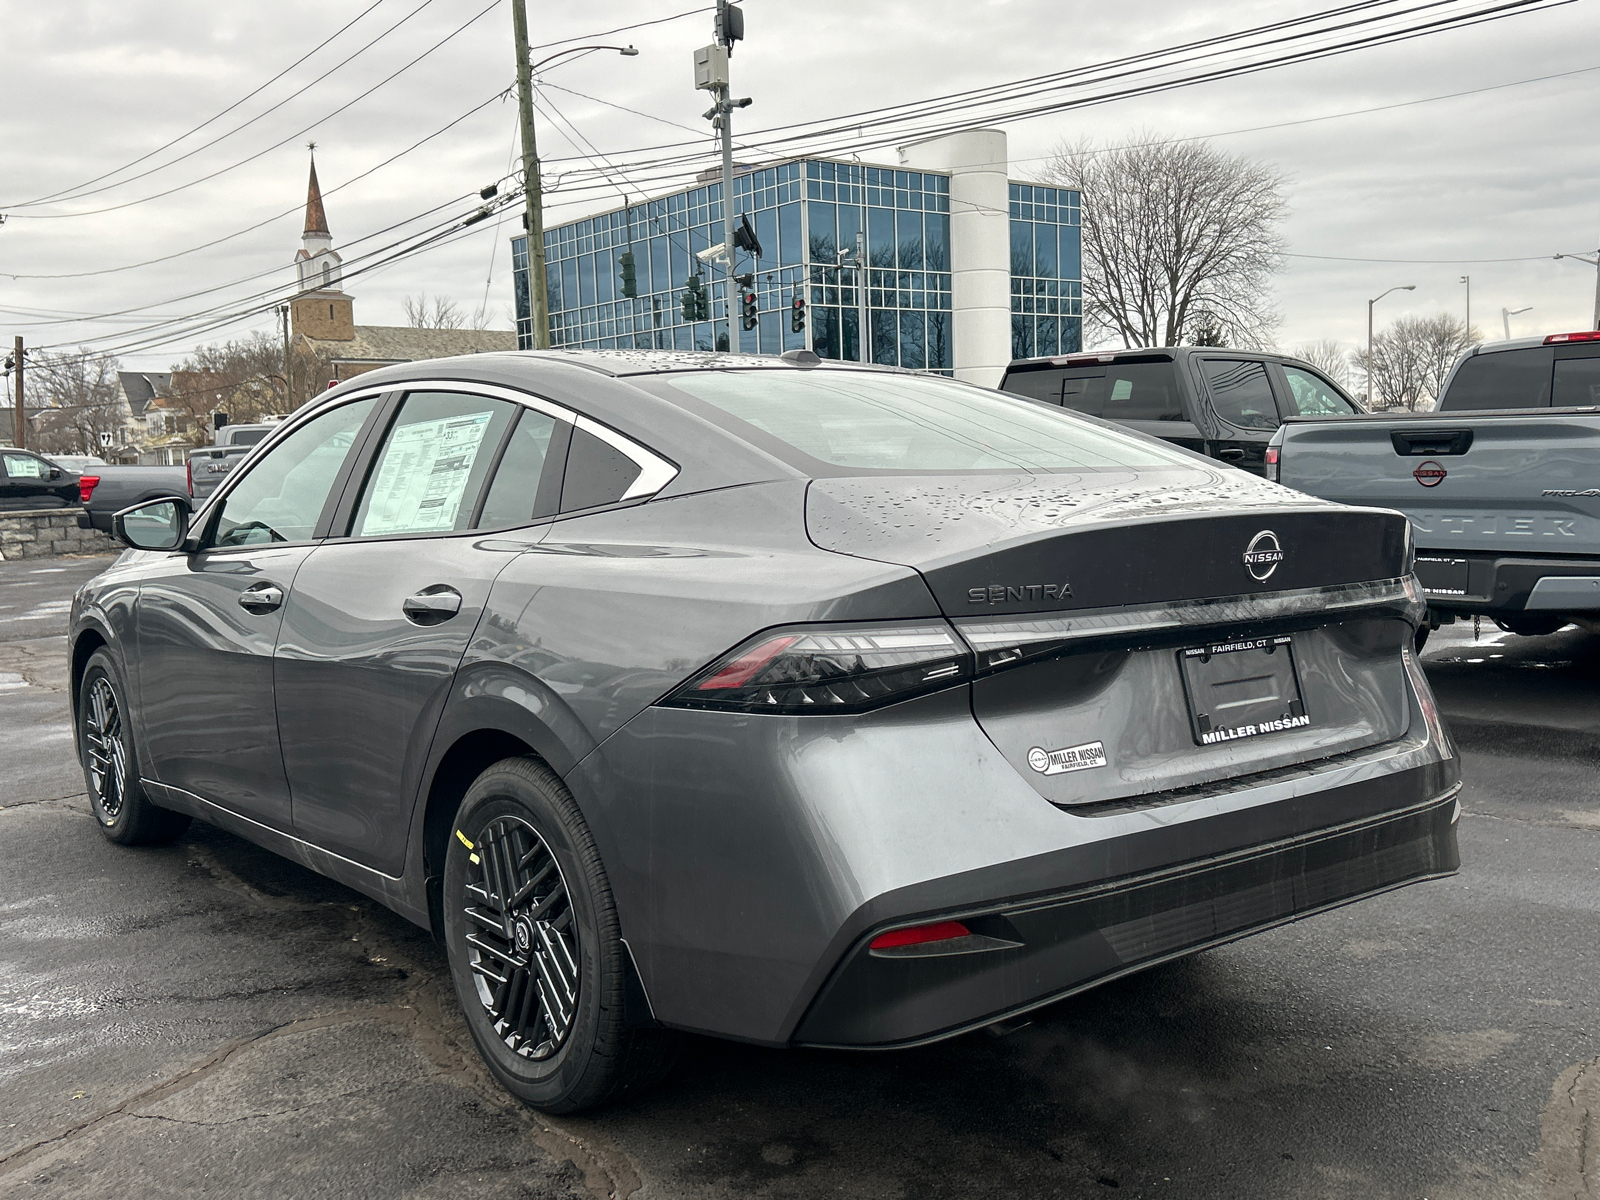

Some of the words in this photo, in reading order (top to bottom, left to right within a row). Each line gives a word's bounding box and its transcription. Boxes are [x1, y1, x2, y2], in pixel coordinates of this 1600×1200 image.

[1406, 514, 1576, 536] NTIER
[1244, 552, 1283, 563] NISSAN
[968, 583, 1073, 603] SENTRA
[1212, 642, 1255, 653] FAIRFIELD,
[1256, 639, 1267, 647] CT
[1273, 636, 1291, 644] NISSAN
[1202, 725, 1257, 744] MILLER
[1259, 715, 1310, 733] NISSAN
[1050, 751, 1077, 766] MILLER
[1078, 747, 1104, 760] NISSAN
[1061, 761, 1089, 769] FAIRFIELD,
